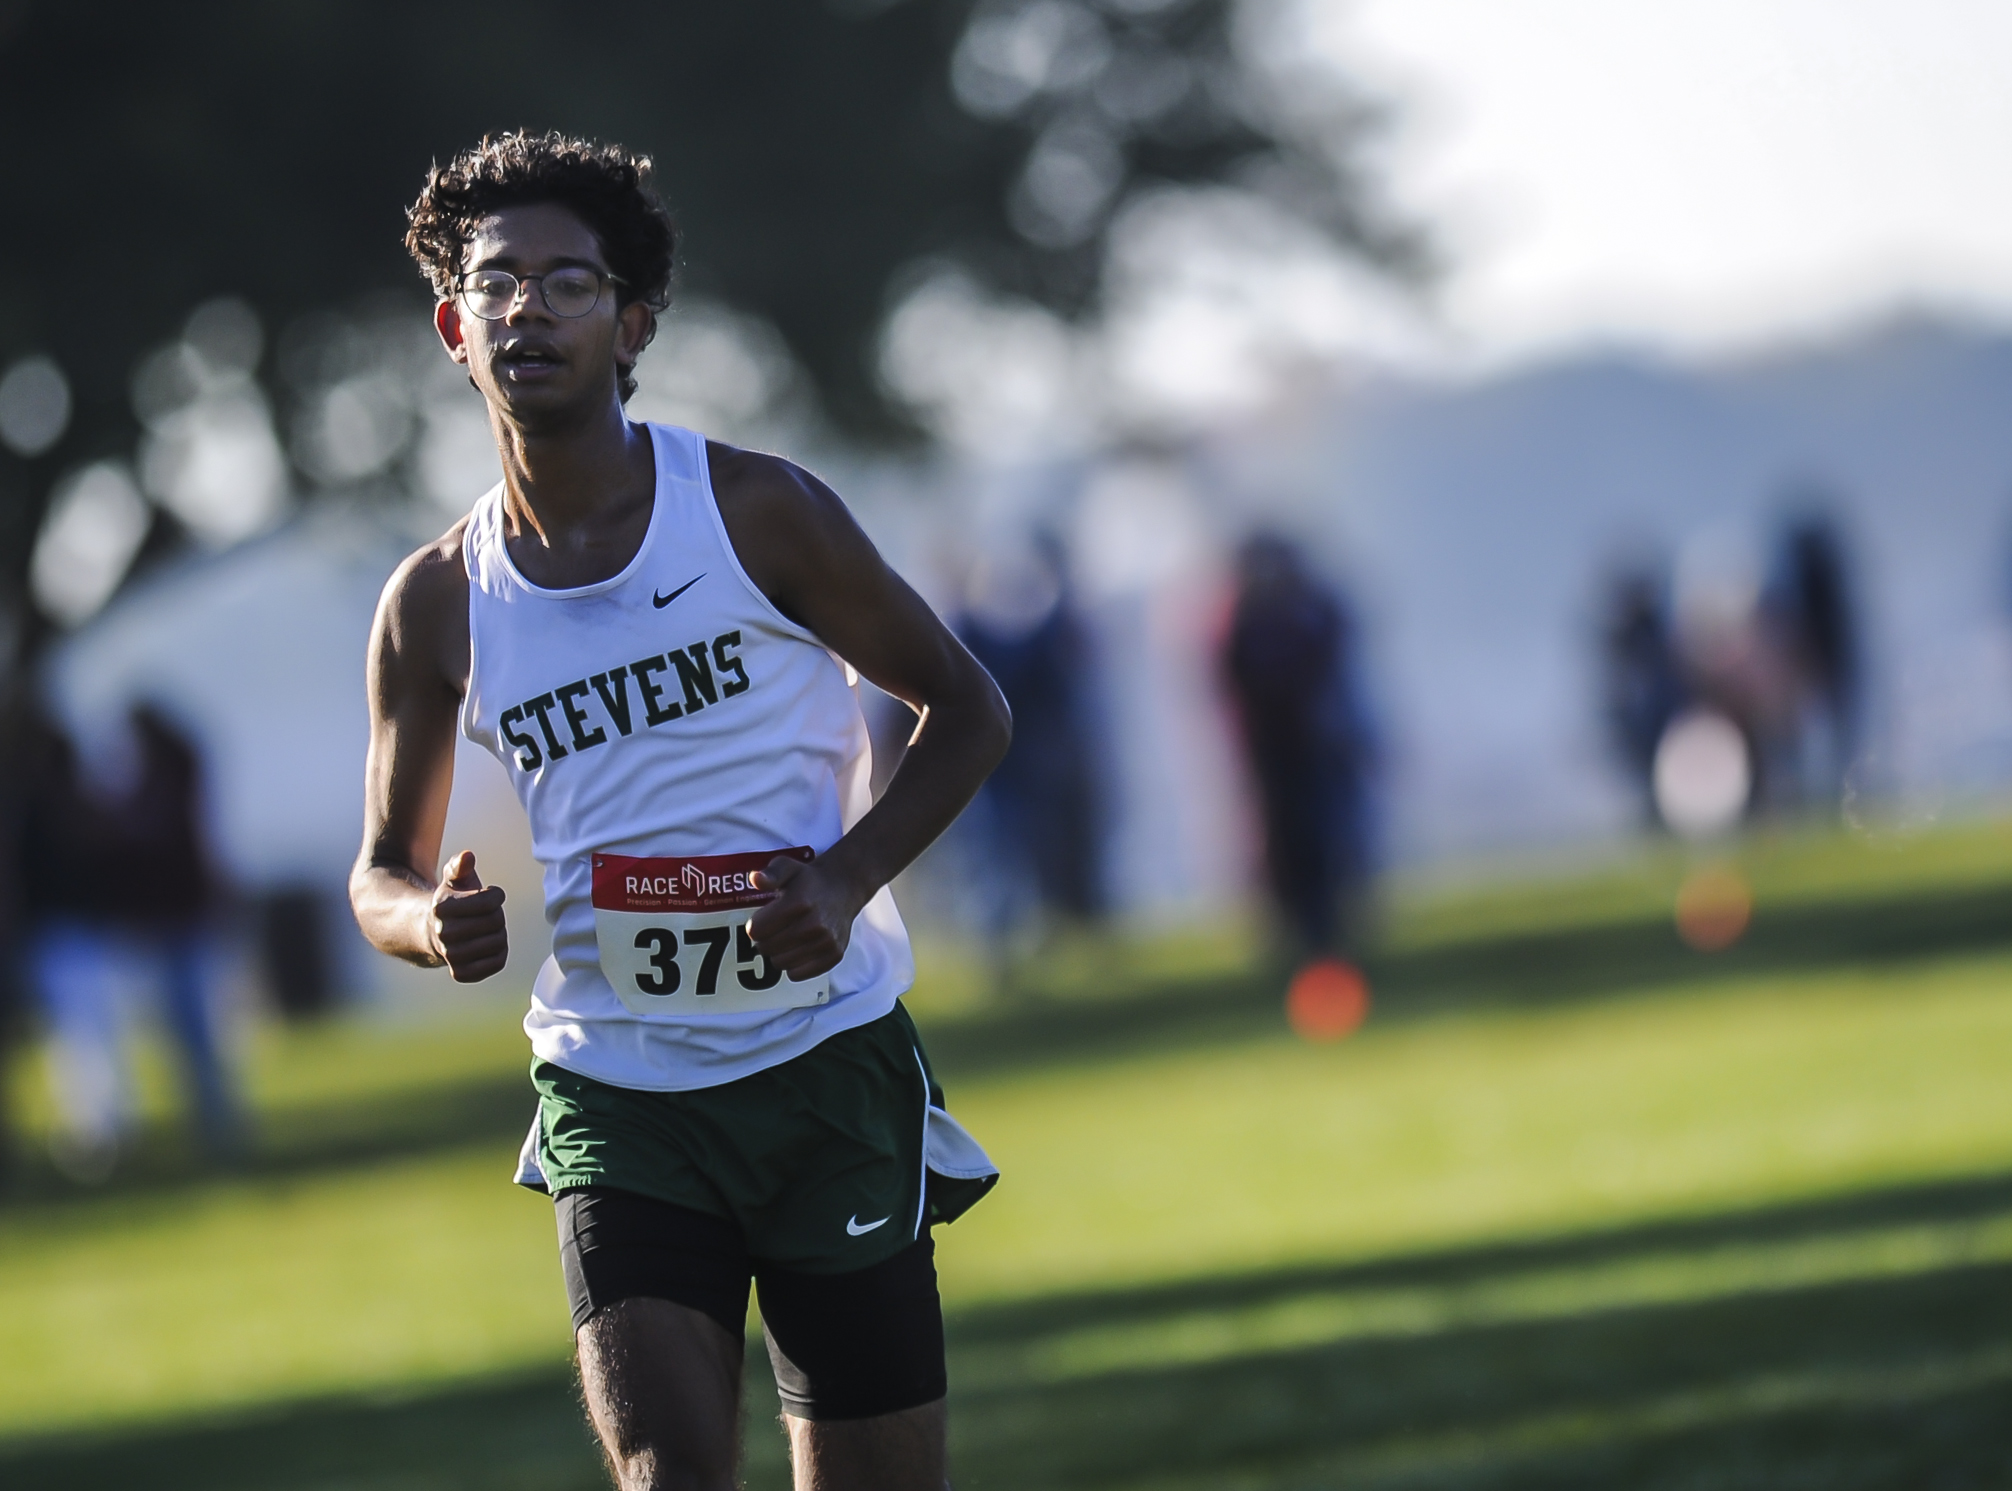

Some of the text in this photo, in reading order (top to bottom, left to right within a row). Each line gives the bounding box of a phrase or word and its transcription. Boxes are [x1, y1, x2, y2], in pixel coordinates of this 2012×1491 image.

[499, 629, 750, 773] STEVENS
[625, 876, 680, 895] RACE
[626, 898, 662, 906] Precision
[667, 898, 697, 906] Passion
[703, 898, 734, 906] German
[633, 925, 782, 997] 375
